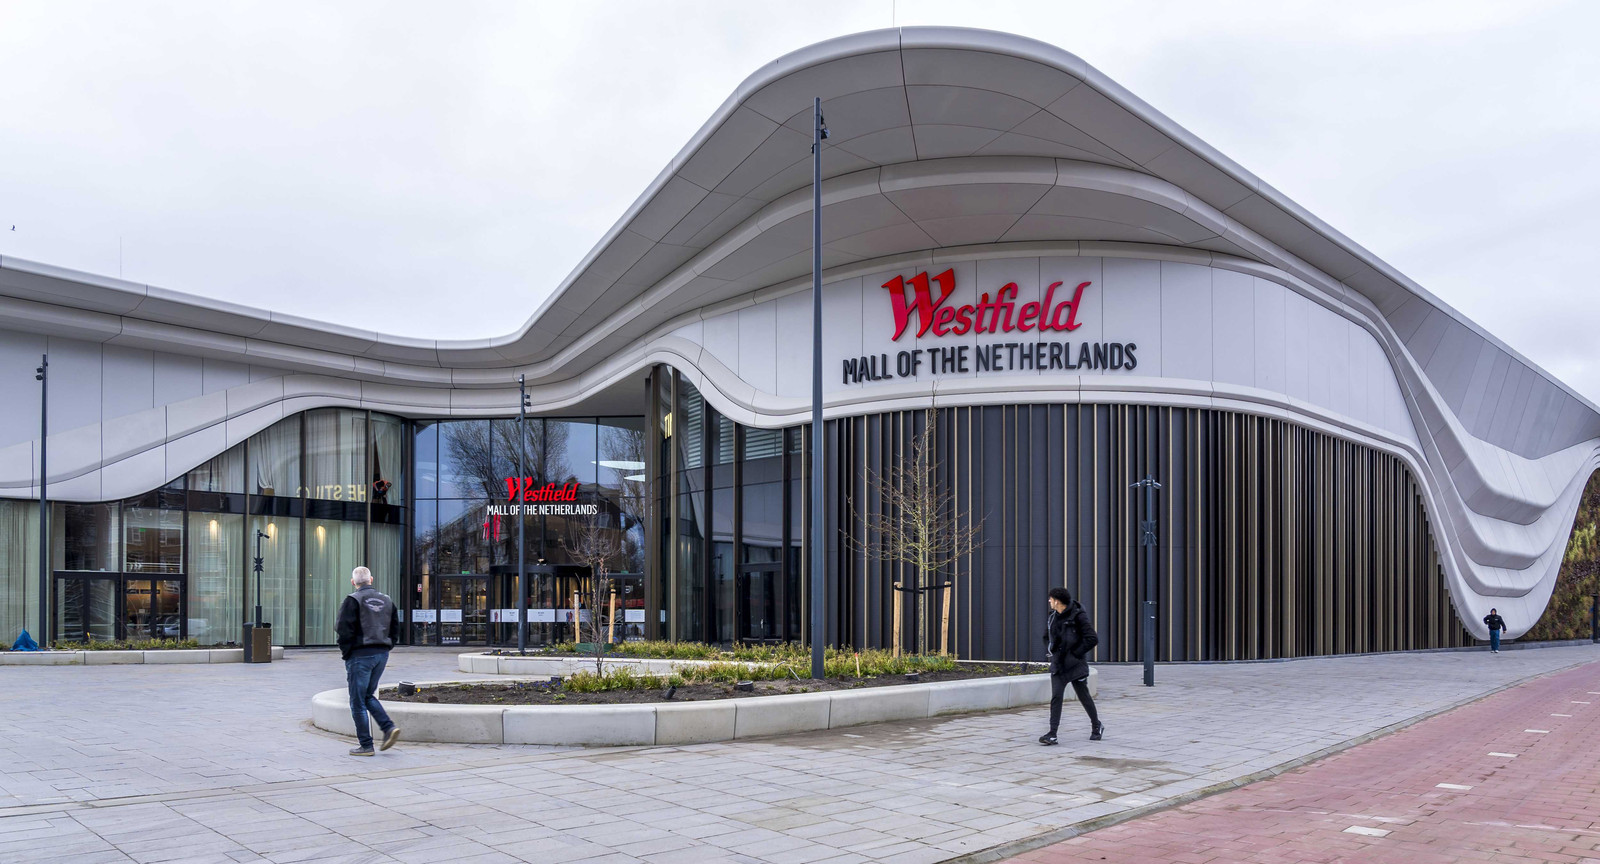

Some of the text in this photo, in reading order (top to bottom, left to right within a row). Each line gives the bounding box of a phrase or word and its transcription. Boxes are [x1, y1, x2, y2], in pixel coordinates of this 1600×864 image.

[881, 268, 1092, 342] Westfield
[842, 342, 1138, 384] MALL OF THE NETHERLANDS
[504, 476, 581, 502] Westfield
[487, 504, 598, 516] MALL OF THE NETHERLANDS
